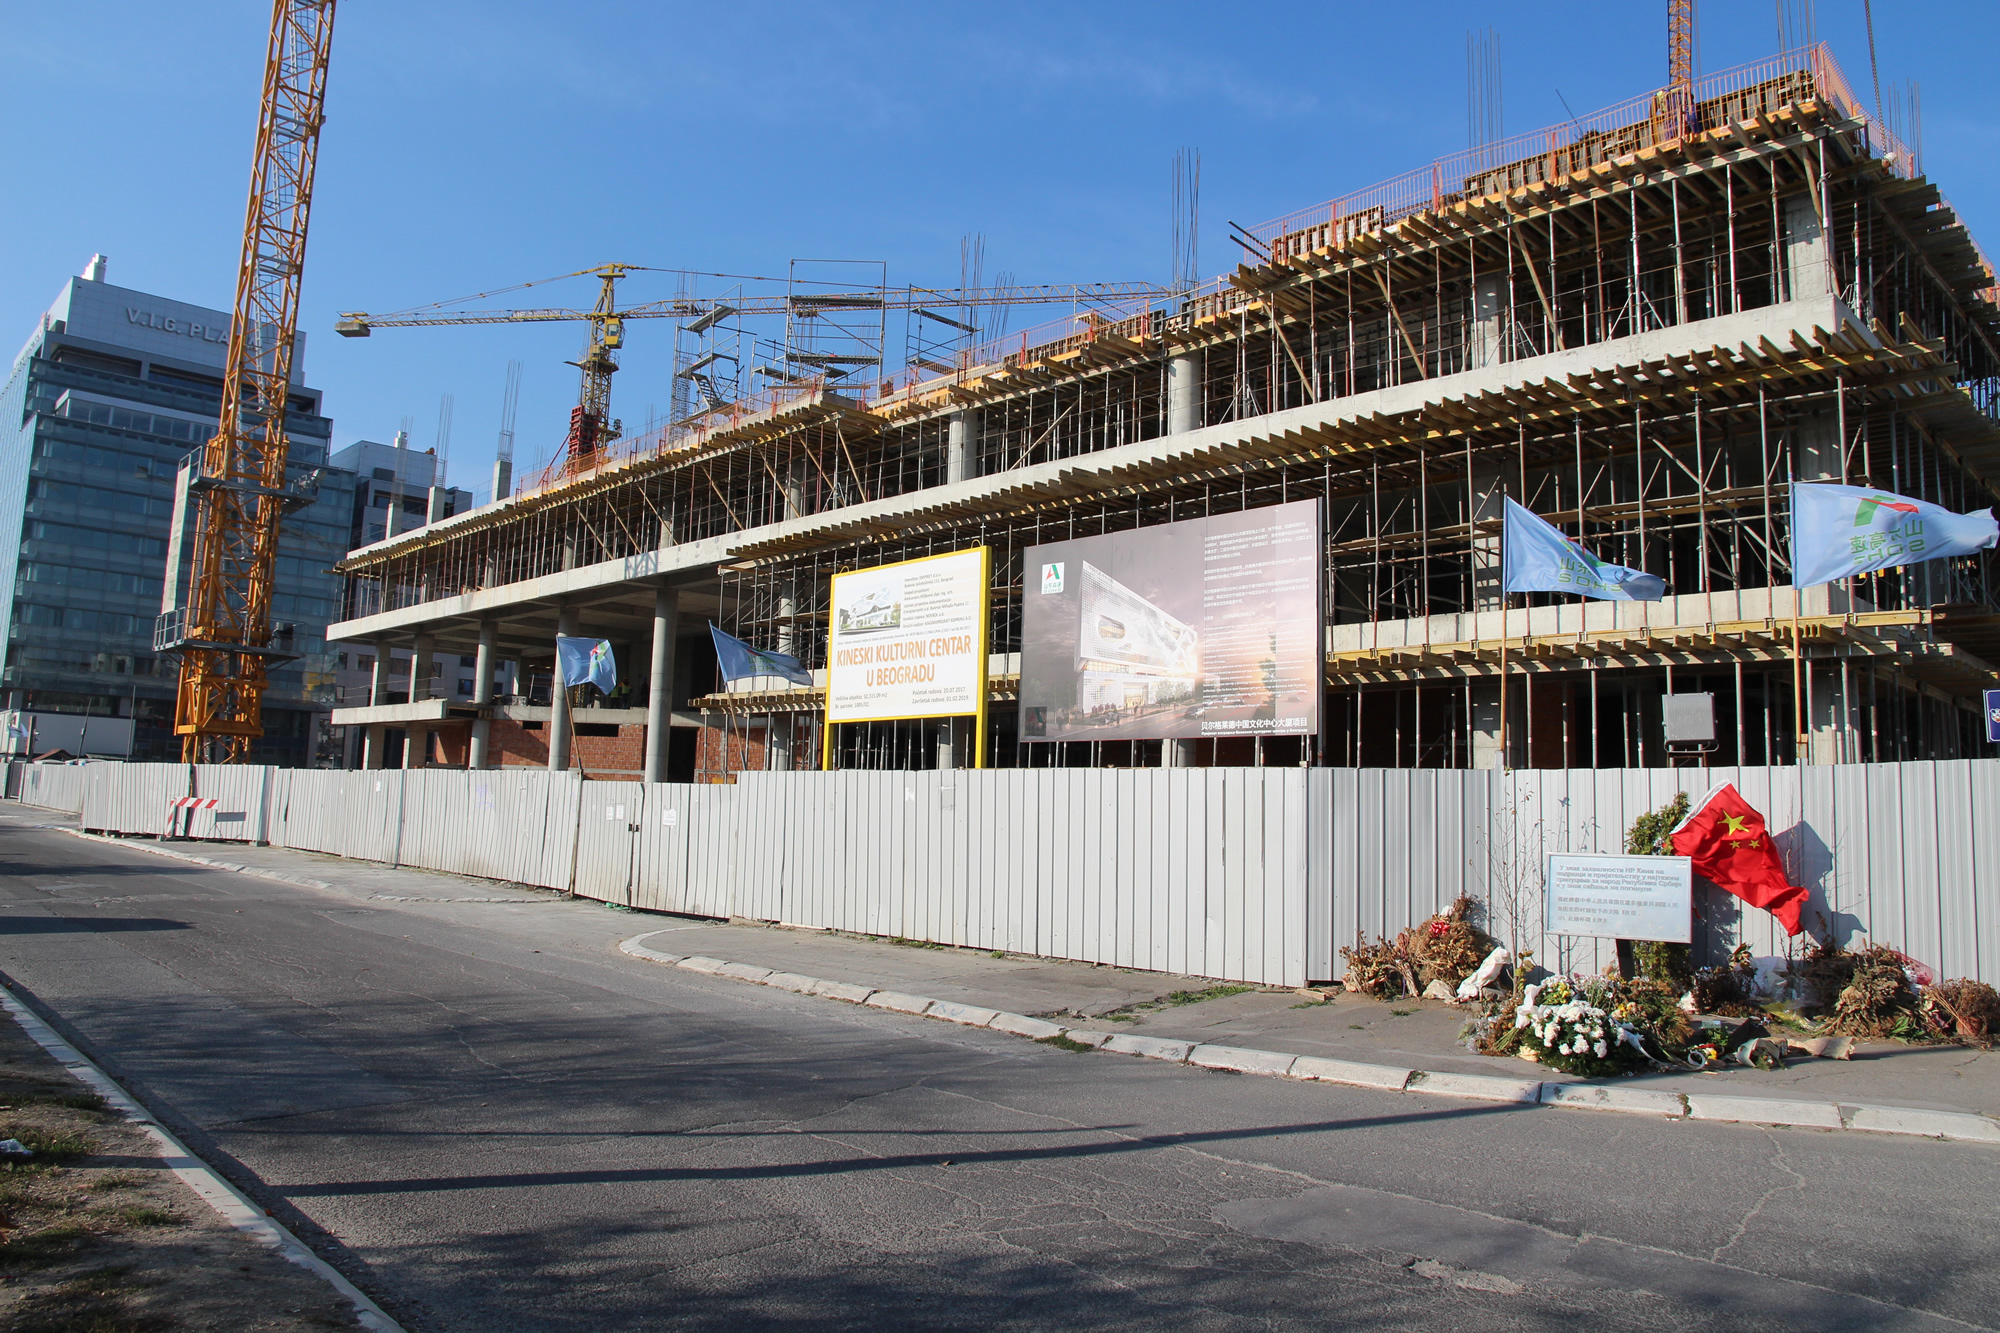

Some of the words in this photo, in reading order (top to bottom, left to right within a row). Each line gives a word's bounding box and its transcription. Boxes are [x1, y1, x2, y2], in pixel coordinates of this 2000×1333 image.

[127, 307, 182, 334] V.I.G.
[189, 323, 260, 350] PLAA
[1558, 573, 1622, 591] SDHS
[837, 646, 873, 666] KINESKI
[876, 640, 926, 662] KULTURNI
[929, 635, 971, 657] CENTAR
[866, 670, 874, 687] U
[877, 664, 935, 686] BEOGRADU
[1201, 717, 1307, 730] 贝尔格莱德中国文化中心大厦项目
